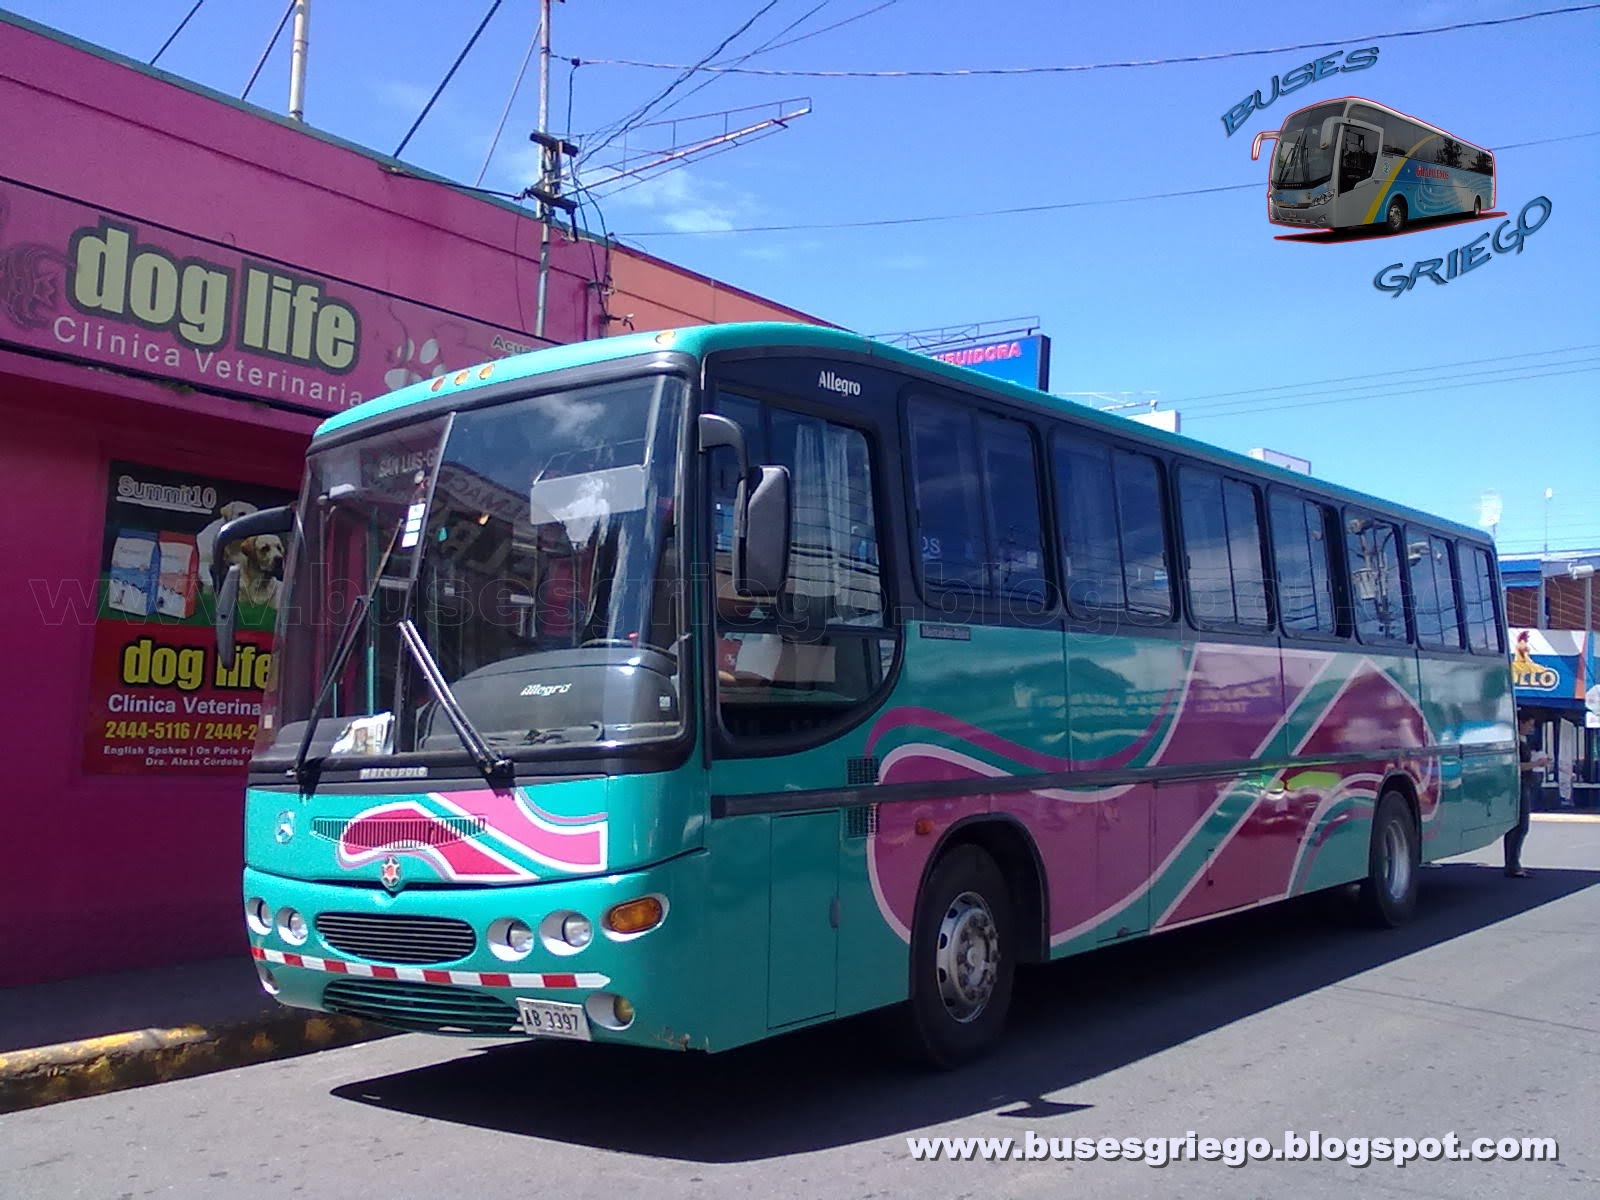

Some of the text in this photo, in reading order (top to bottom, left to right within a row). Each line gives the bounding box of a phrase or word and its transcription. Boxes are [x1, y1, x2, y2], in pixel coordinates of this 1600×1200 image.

[75, 228, 357, 370] dog life
[53, 316, 363, 408] Clínica Veterinaria
[818, 370, 861, 397] Allegro
[117, 475, 217, 510] Summit10
[123, 639, 204, 690] dog
[108, 694, 176, 714] Clínica
[105, 720, 191, 739] 2444-5116
[193, 722, 201, 739] /
[104, 745, 144, 756] English
[149, 746, 187, 756] Spoken
[524, 1009, 578, 1031] AB 3397
